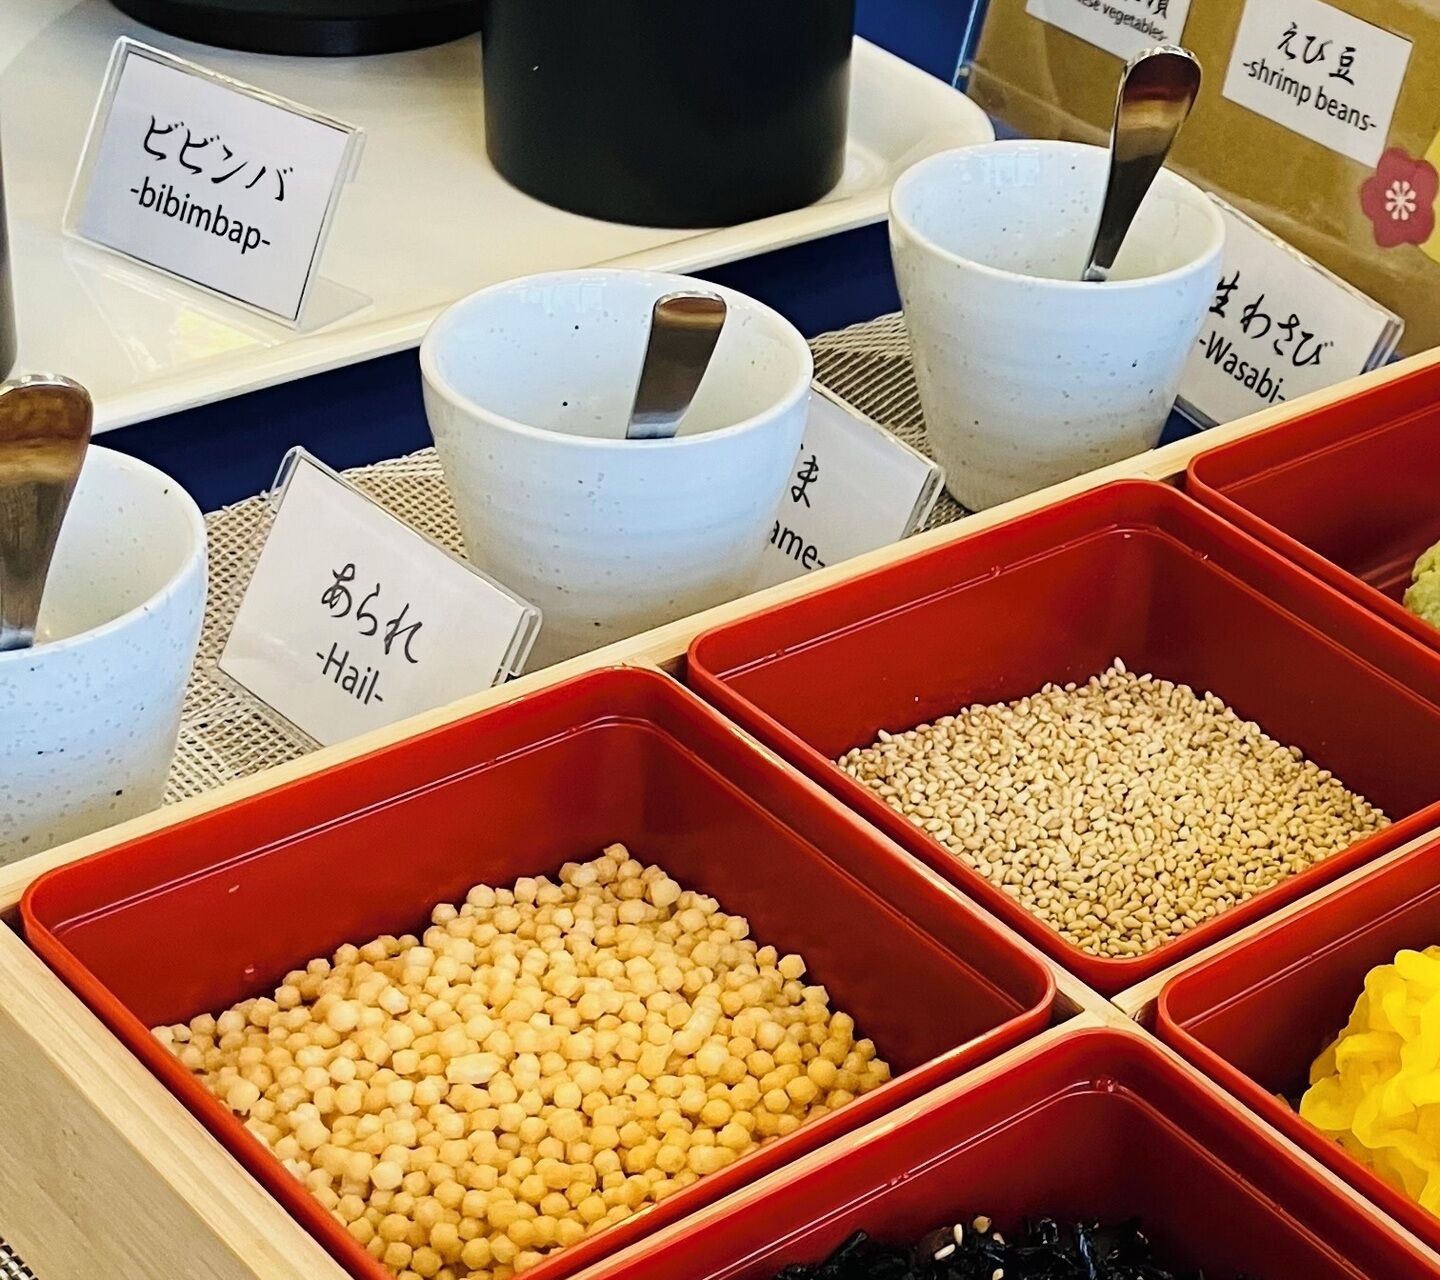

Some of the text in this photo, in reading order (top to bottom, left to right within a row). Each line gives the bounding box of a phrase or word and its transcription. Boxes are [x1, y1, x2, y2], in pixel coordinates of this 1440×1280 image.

[1277, 22, 1357, 87] えび豆
[1243, 58, 1377, 133] -shrimp beans-
[143, 114, 295, 202] ビビンバ
[129, 177, 272, 254] -bibimbap-
[1208, 270, 1334, 367] 生わさび
[1198, 331, 1287, 404] -Wasabi-
[790, 443, 820, 509] ま
[321, 562, 427, 665] あられ
[315, 644, 384, 704] -Hail-
